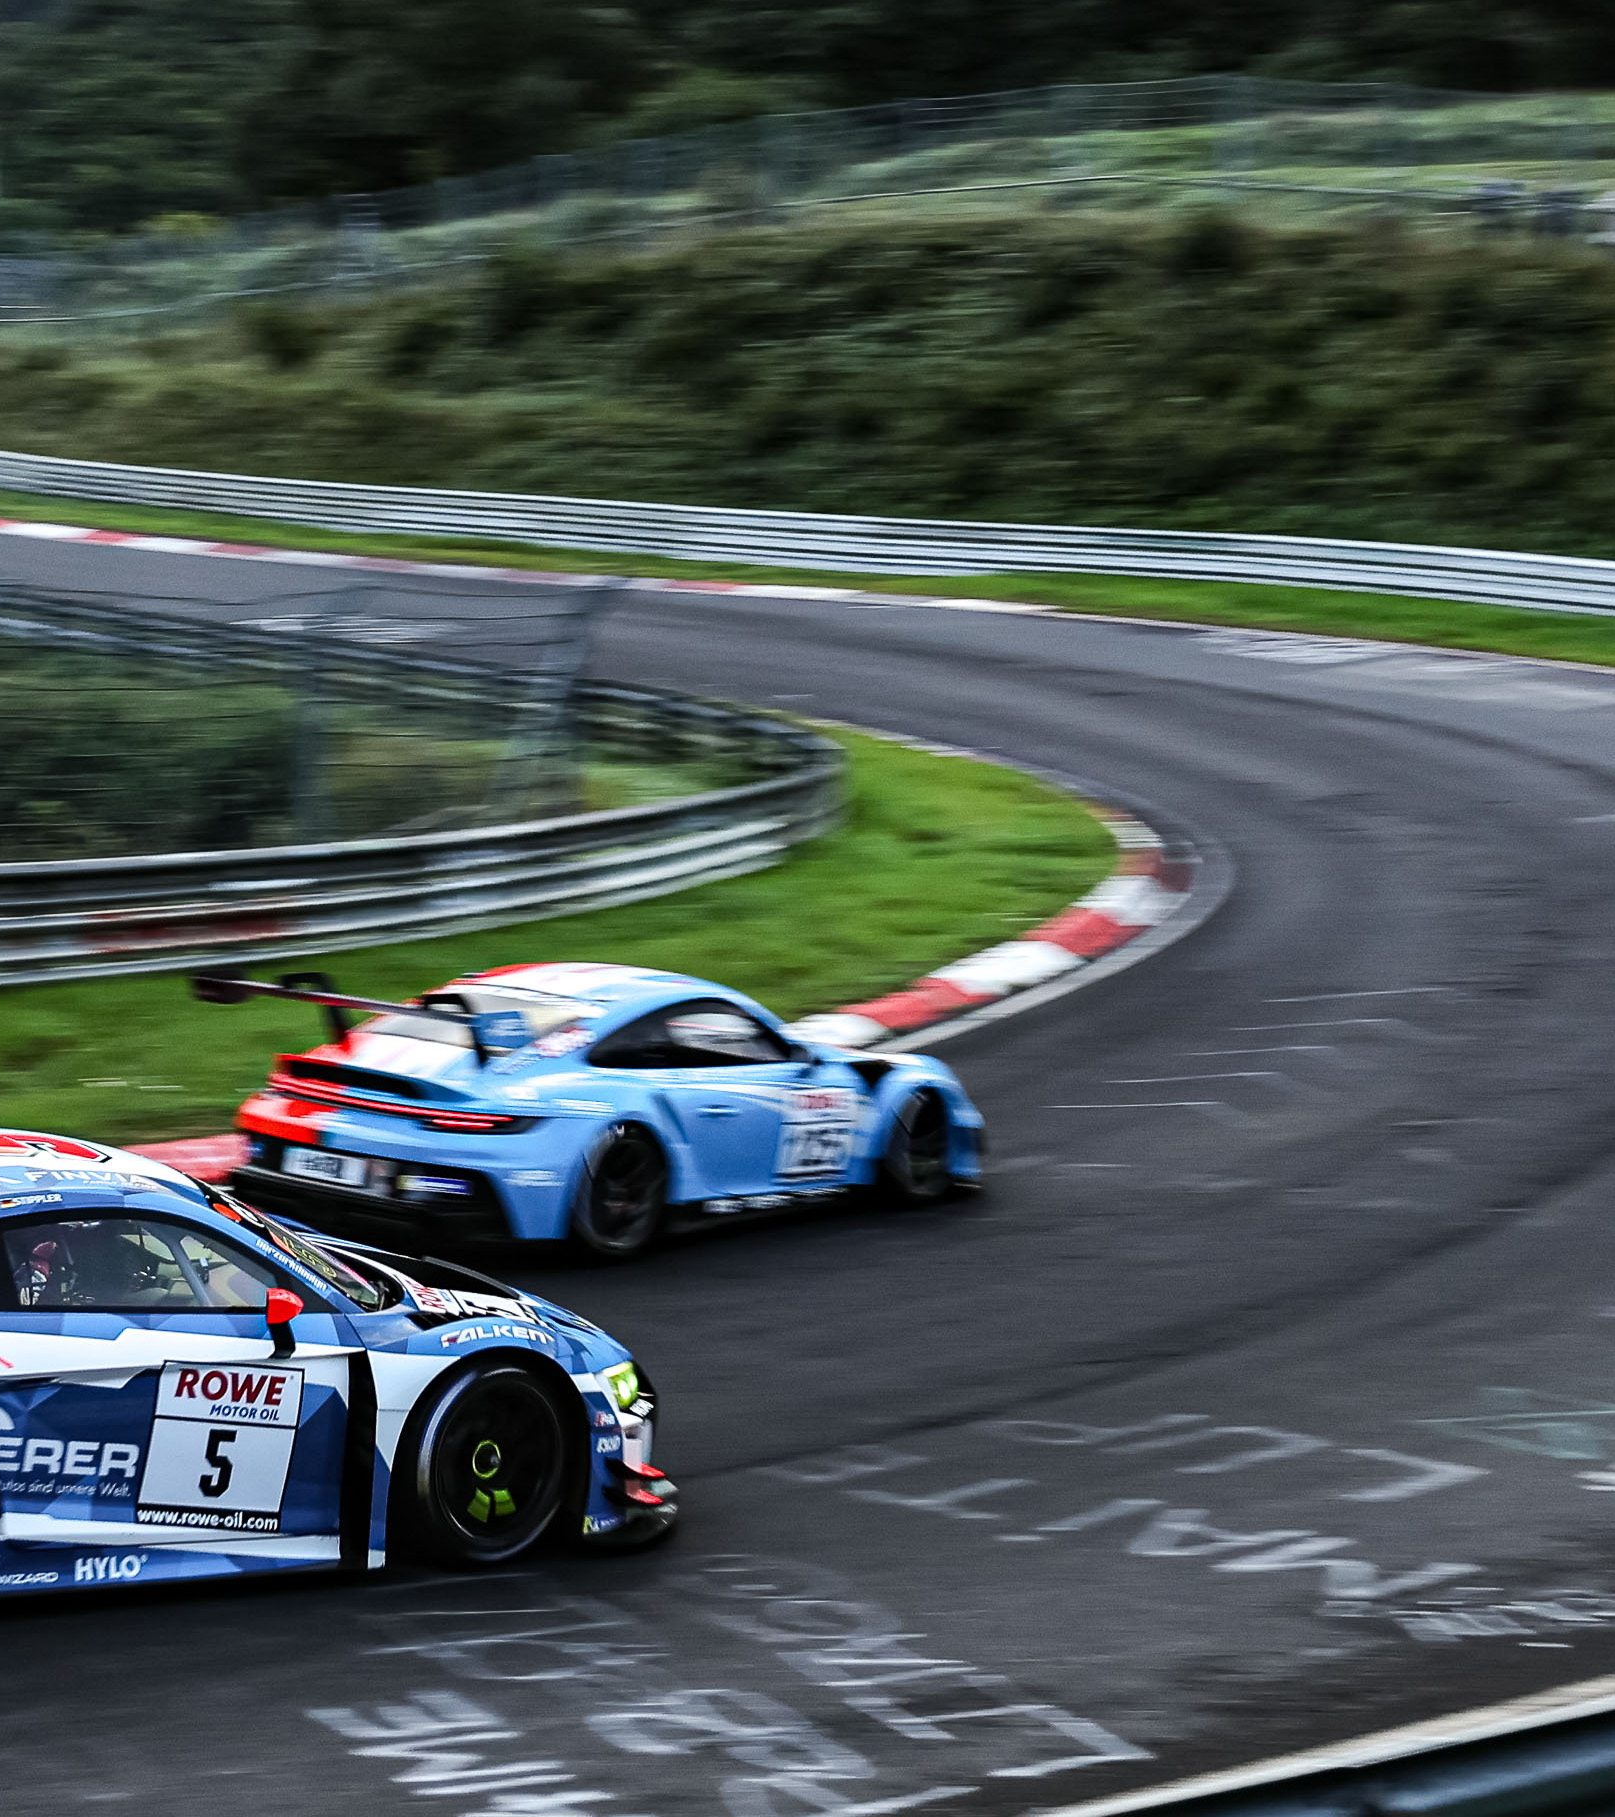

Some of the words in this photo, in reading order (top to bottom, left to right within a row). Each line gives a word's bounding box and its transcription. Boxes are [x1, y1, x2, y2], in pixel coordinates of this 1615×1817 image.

[24, 1171, 150, 1186] FINVIA
[441, 1325, 555, 1348] FALKEN
[174, 1368, 287, 1406] ROWE
[209, 1404, 256, 1421] MOTOR
[259, 1408, 280, 1421] OIL
[198, 1428, 237, 1498] 5
[137, 1509, 279, 1531] www.rowe-oil.com
